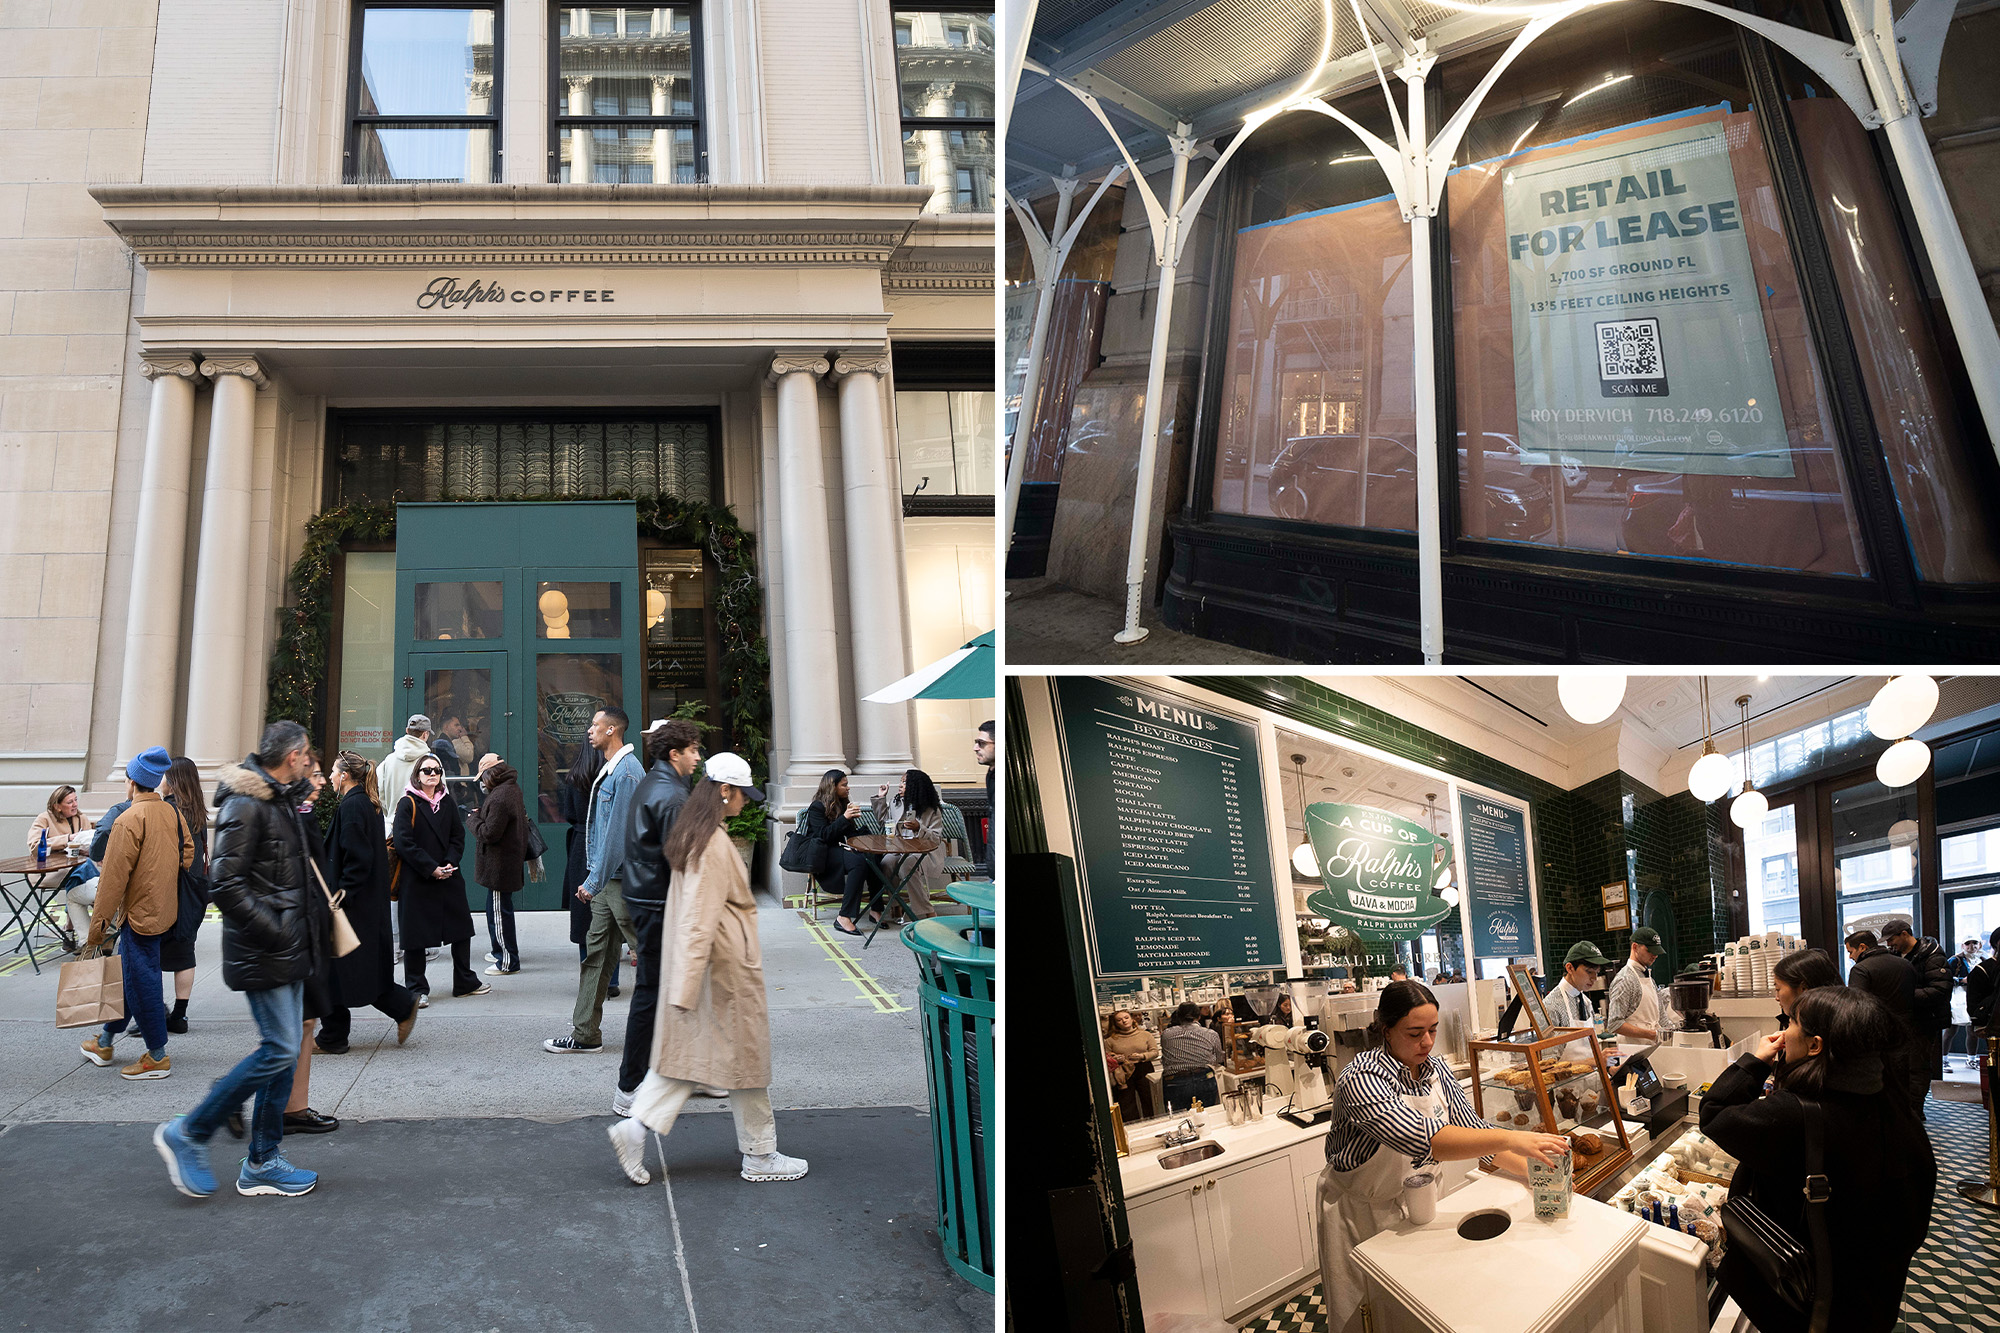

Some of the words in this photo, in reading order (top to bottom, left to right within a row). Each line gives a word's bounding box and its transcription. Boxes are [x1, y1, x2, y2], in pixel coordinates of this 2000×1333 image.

[1539, 168, 1687, 218] RETAIL
[1510, 224, 1586, 261] FOR
[1594, 200, 1740, 248] LEASE
[1550, 269, 1586, 285] 1,700
[1588, 266, 1606, 280] SF
[1609, 258, 1674, 276] GROUND
[1677, 256, 1696, 268] FL
[416, 276, 505, 310] Ralph's
[510, 290, 614, 302] COFFEE
[1530, 300, 1557, 314] 13'5
[1560, 296, 1593, 311] FEET
[1596, 290, 1656, 308] CEILING
[1659, 283, 1730, 302] HEIGHTS
[1005, 305, 1023, 321] AIL
[1005, 325, 1030, 342] ASE
[1611, 384, 1639, 394] SCAN
[1641, 384, 1658, 394] ME
[1530, 408, 1563, 422] ROY
[1565, 408, 1633, 422] DERVICH
[1645, 406, 1764, 424] 718.249.6120
[550, 705, 590, 726] Ralph's
[1136, 696, 1203, 730] MENU
[1106, 733, 1140, 746] RALPH'S
[1141, 742, 1166, 752] ROAST
[1133, 722, 1213, 750] BEVERAGES
[1108, 742, 1141, 754] RALPH'S
[1142, 751, 1179, 763] ESPRESSO
[1109, 751, 1136, 762] LATTE
[1110, 761, 1162, 776] CAPPUCCINO
[1112, 770, 1160, 784] AMERICANO
[1114, 779, 1152, 791] CORTADO
[1114, 788, 1145, 798] MOCHA
[1116, 797, 1136, 805] CHAI
[1138, 801, 1162, 809] LATTE
[1482, 804, 1504, 818] MENU
[1117, 806, 1151, 817] MATCHA
[1152, 812, 1176, 820] LATTE
[1361, 810, 1393, 823] ENJOY
[1118, 815, 1151, 824] RALPH'S
[1170, 823, 1212, 834] CHOCOLATE
[1120, 824, 1152, 833] RALPH'S
[1340, 816, 1354, 828] A
[1360, 819, 1394, 835] CUP
[1398, 828, 1418, 843] OF
[1122, 842, 1160, 851] ESPRESSO
[1146, 862, 1190, 871] AMERICANO
[1326, 838, 1422, 893] Ralph's
[1370, 879, 1422, 892] COFFEE
[1352, 894, 1378, 908] JAVA
[1379, 901, 1386, 909] &
[1387, 900, 1415, 911] MOCHA
[1358, 920, 1385, 928] RALPH
[1388, 921, 1418, 929] LAUREN
[1489, 918, 1518, 936] Ralph's
[1379, 932, 1404, 940] N.Y.C.
[1329, 954, 1386, 967] RALPH
[1396, 952, 1450, 964] LAUREN
